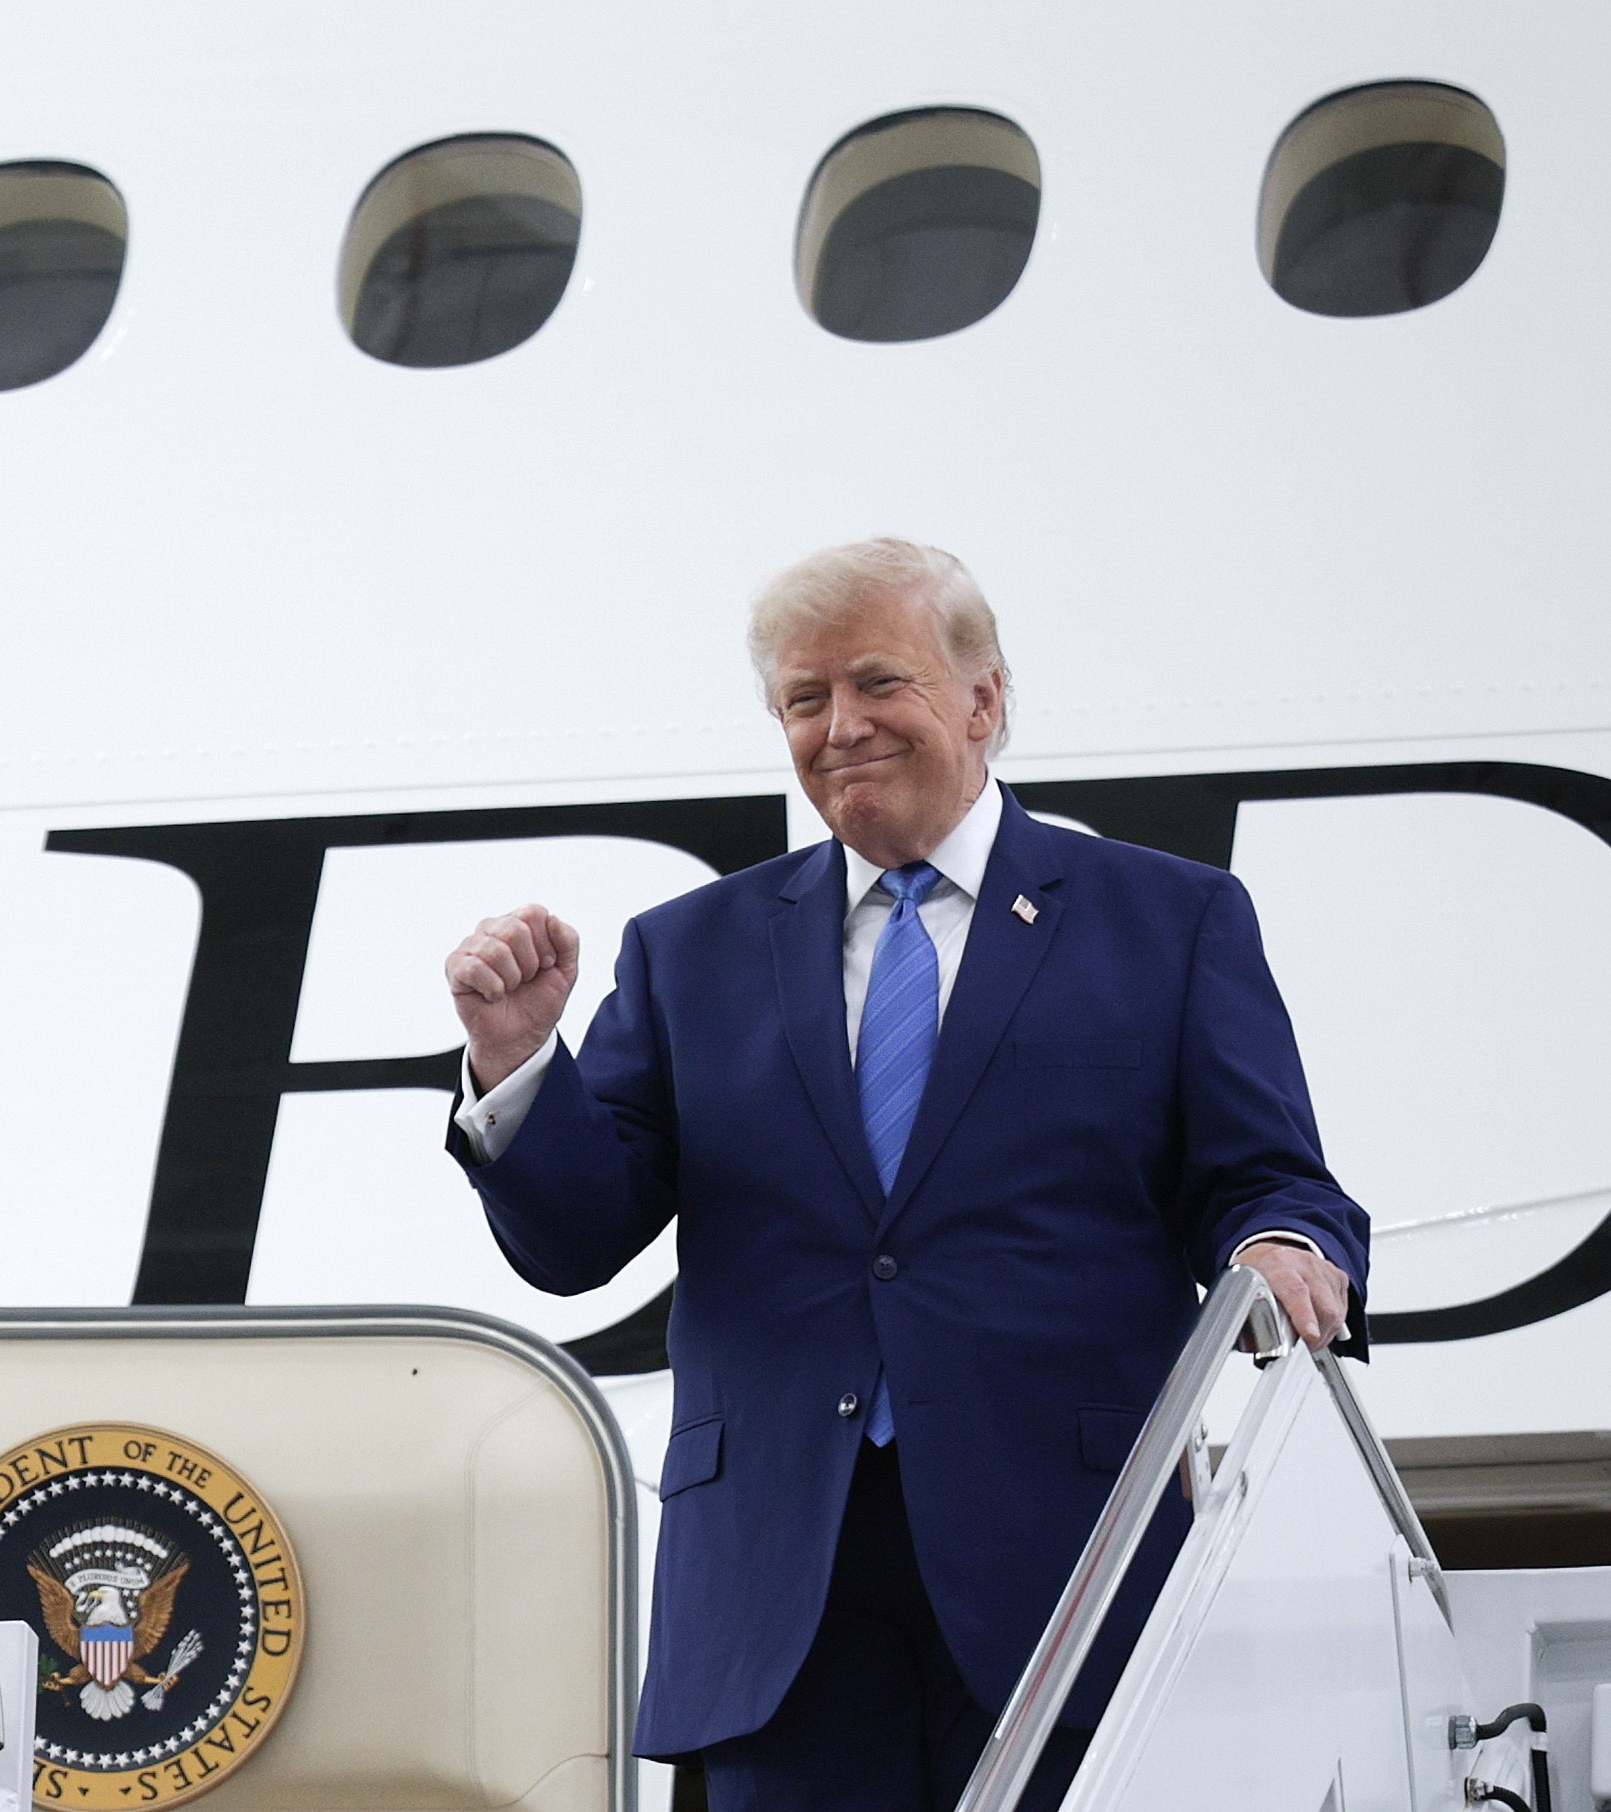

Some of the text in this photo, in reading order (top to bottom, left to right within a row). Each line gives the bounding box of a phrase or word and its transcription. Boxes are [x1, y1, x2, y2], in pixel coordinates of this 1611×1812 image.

[124, 1440, 156, 1463] OF
[168, 1452, 211, 1489] THE
[223, 1492, 292, 1657] UNITED
[137, 1686, 271, 1800] STATES
